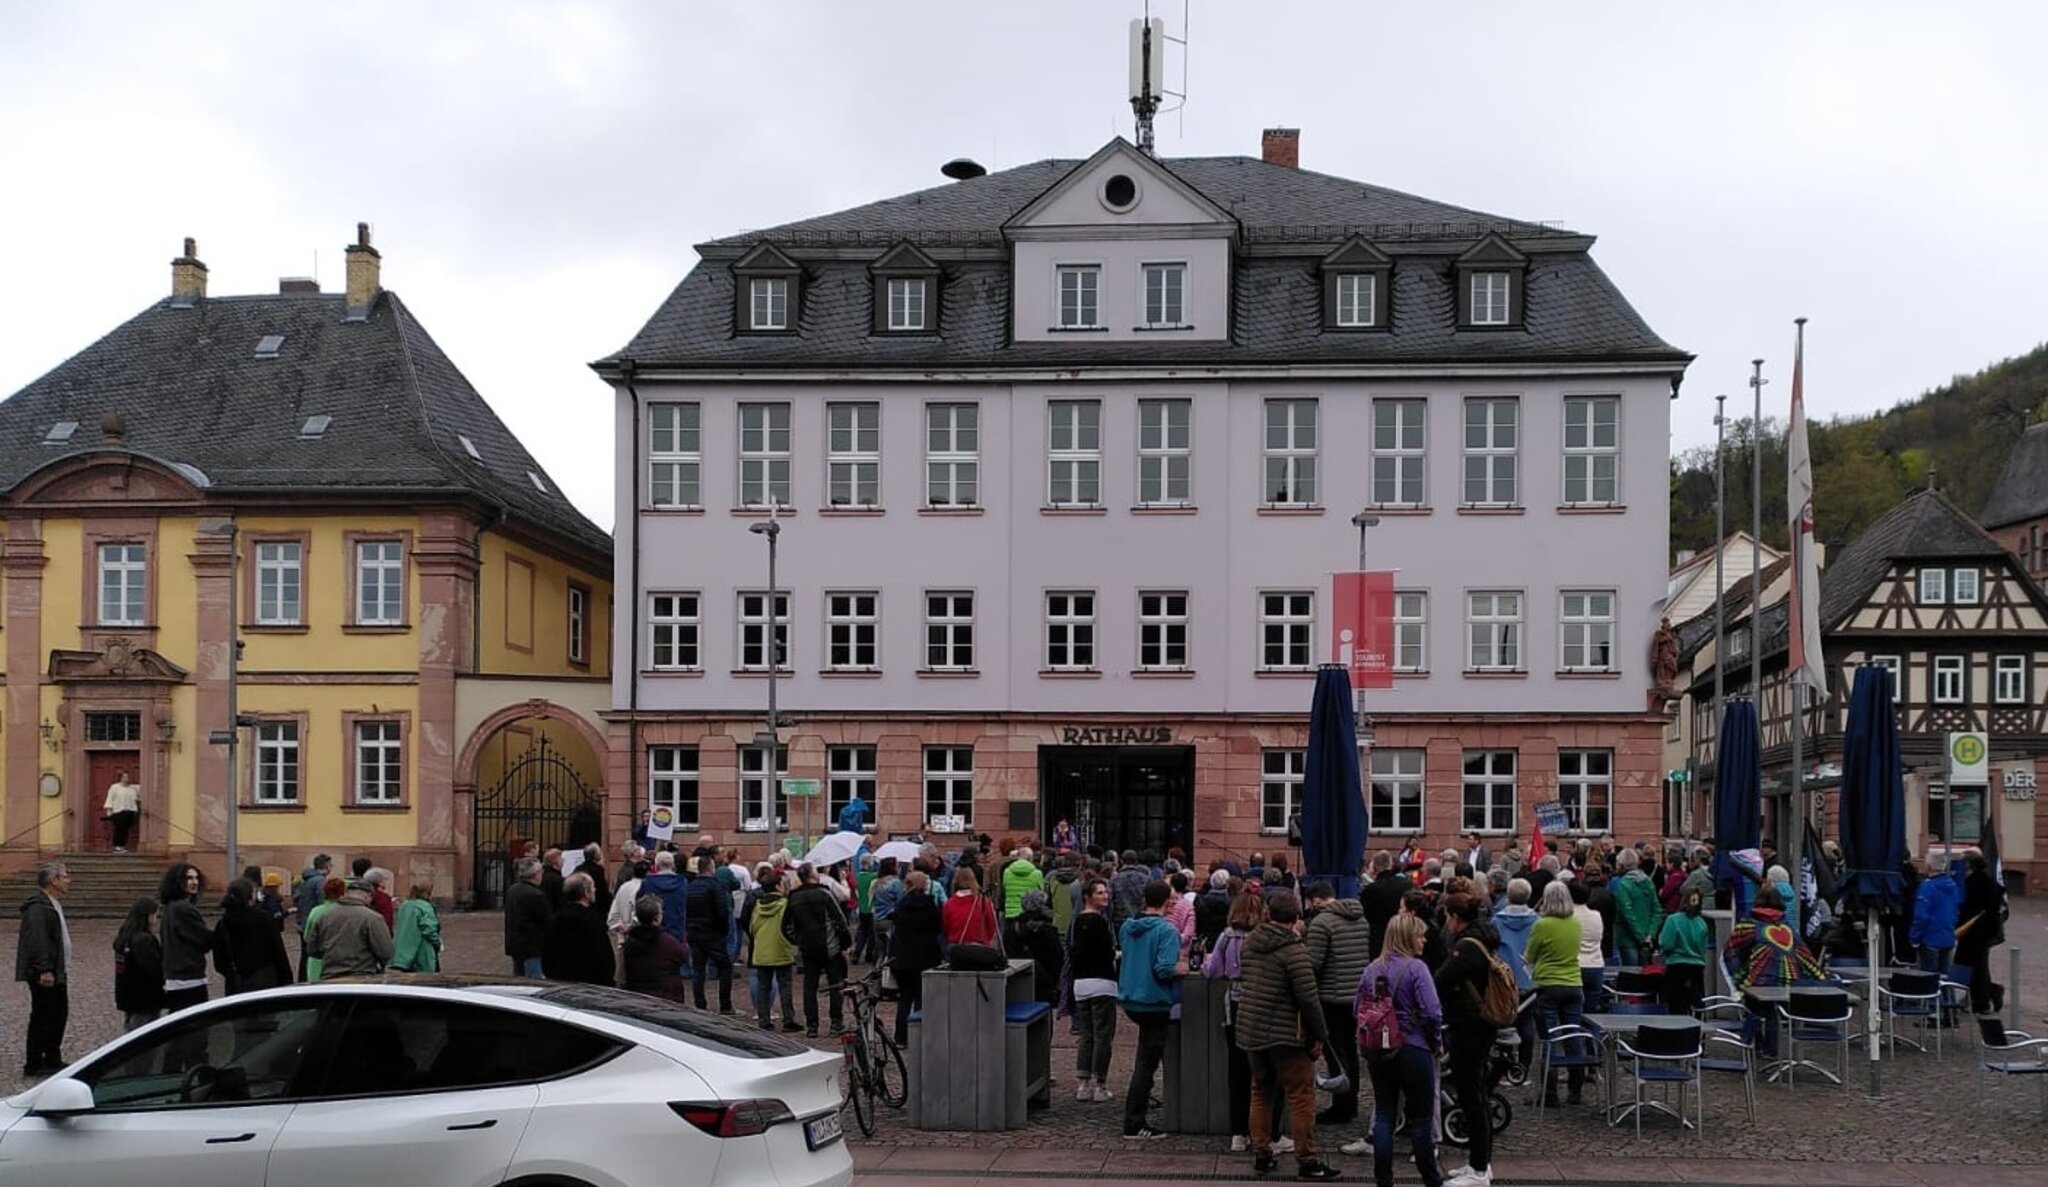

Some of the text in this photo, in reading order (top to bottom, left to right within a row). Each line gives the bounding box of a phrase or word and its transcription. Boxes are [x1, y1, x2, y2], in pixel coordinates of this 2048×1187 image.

[1063, 726, 1172, 744] RATHAUS
[1961, 741, 1977, 759] H
[2004, 773, 2037, 787] DER
[2006, 788, 2038, 800] TOUR
